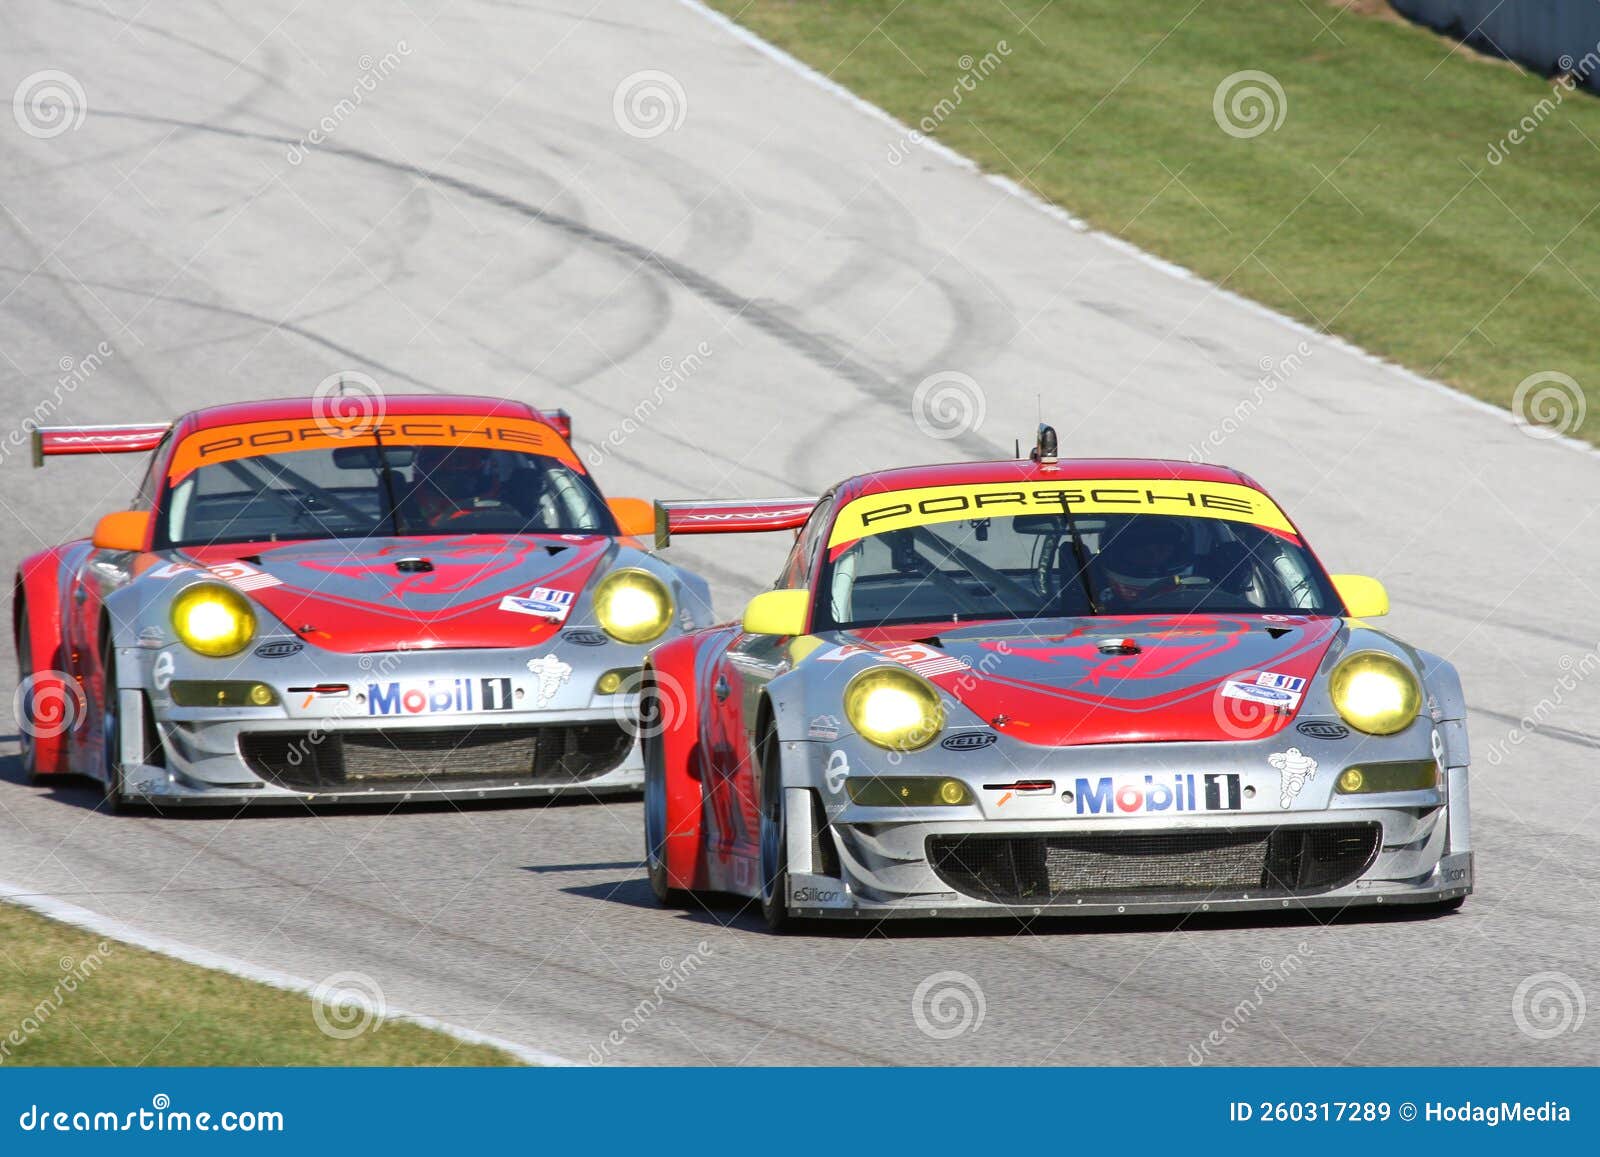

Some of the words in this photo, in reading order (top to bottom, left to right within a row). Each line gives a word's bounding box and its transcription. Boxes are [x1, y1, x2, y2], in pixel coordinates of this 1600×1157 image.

[199, 423, 544, 457] PORSCHE
[861, 488, 1254, 527] PORSCHE
[367, 678, 474, 716] Mobil
[484, 678, 509, 710] 1
[943, 734, 998, 748] HELLA
[1074, 773, 1197, 814] Mobil
[1208, 774, 1235, 810] 1
